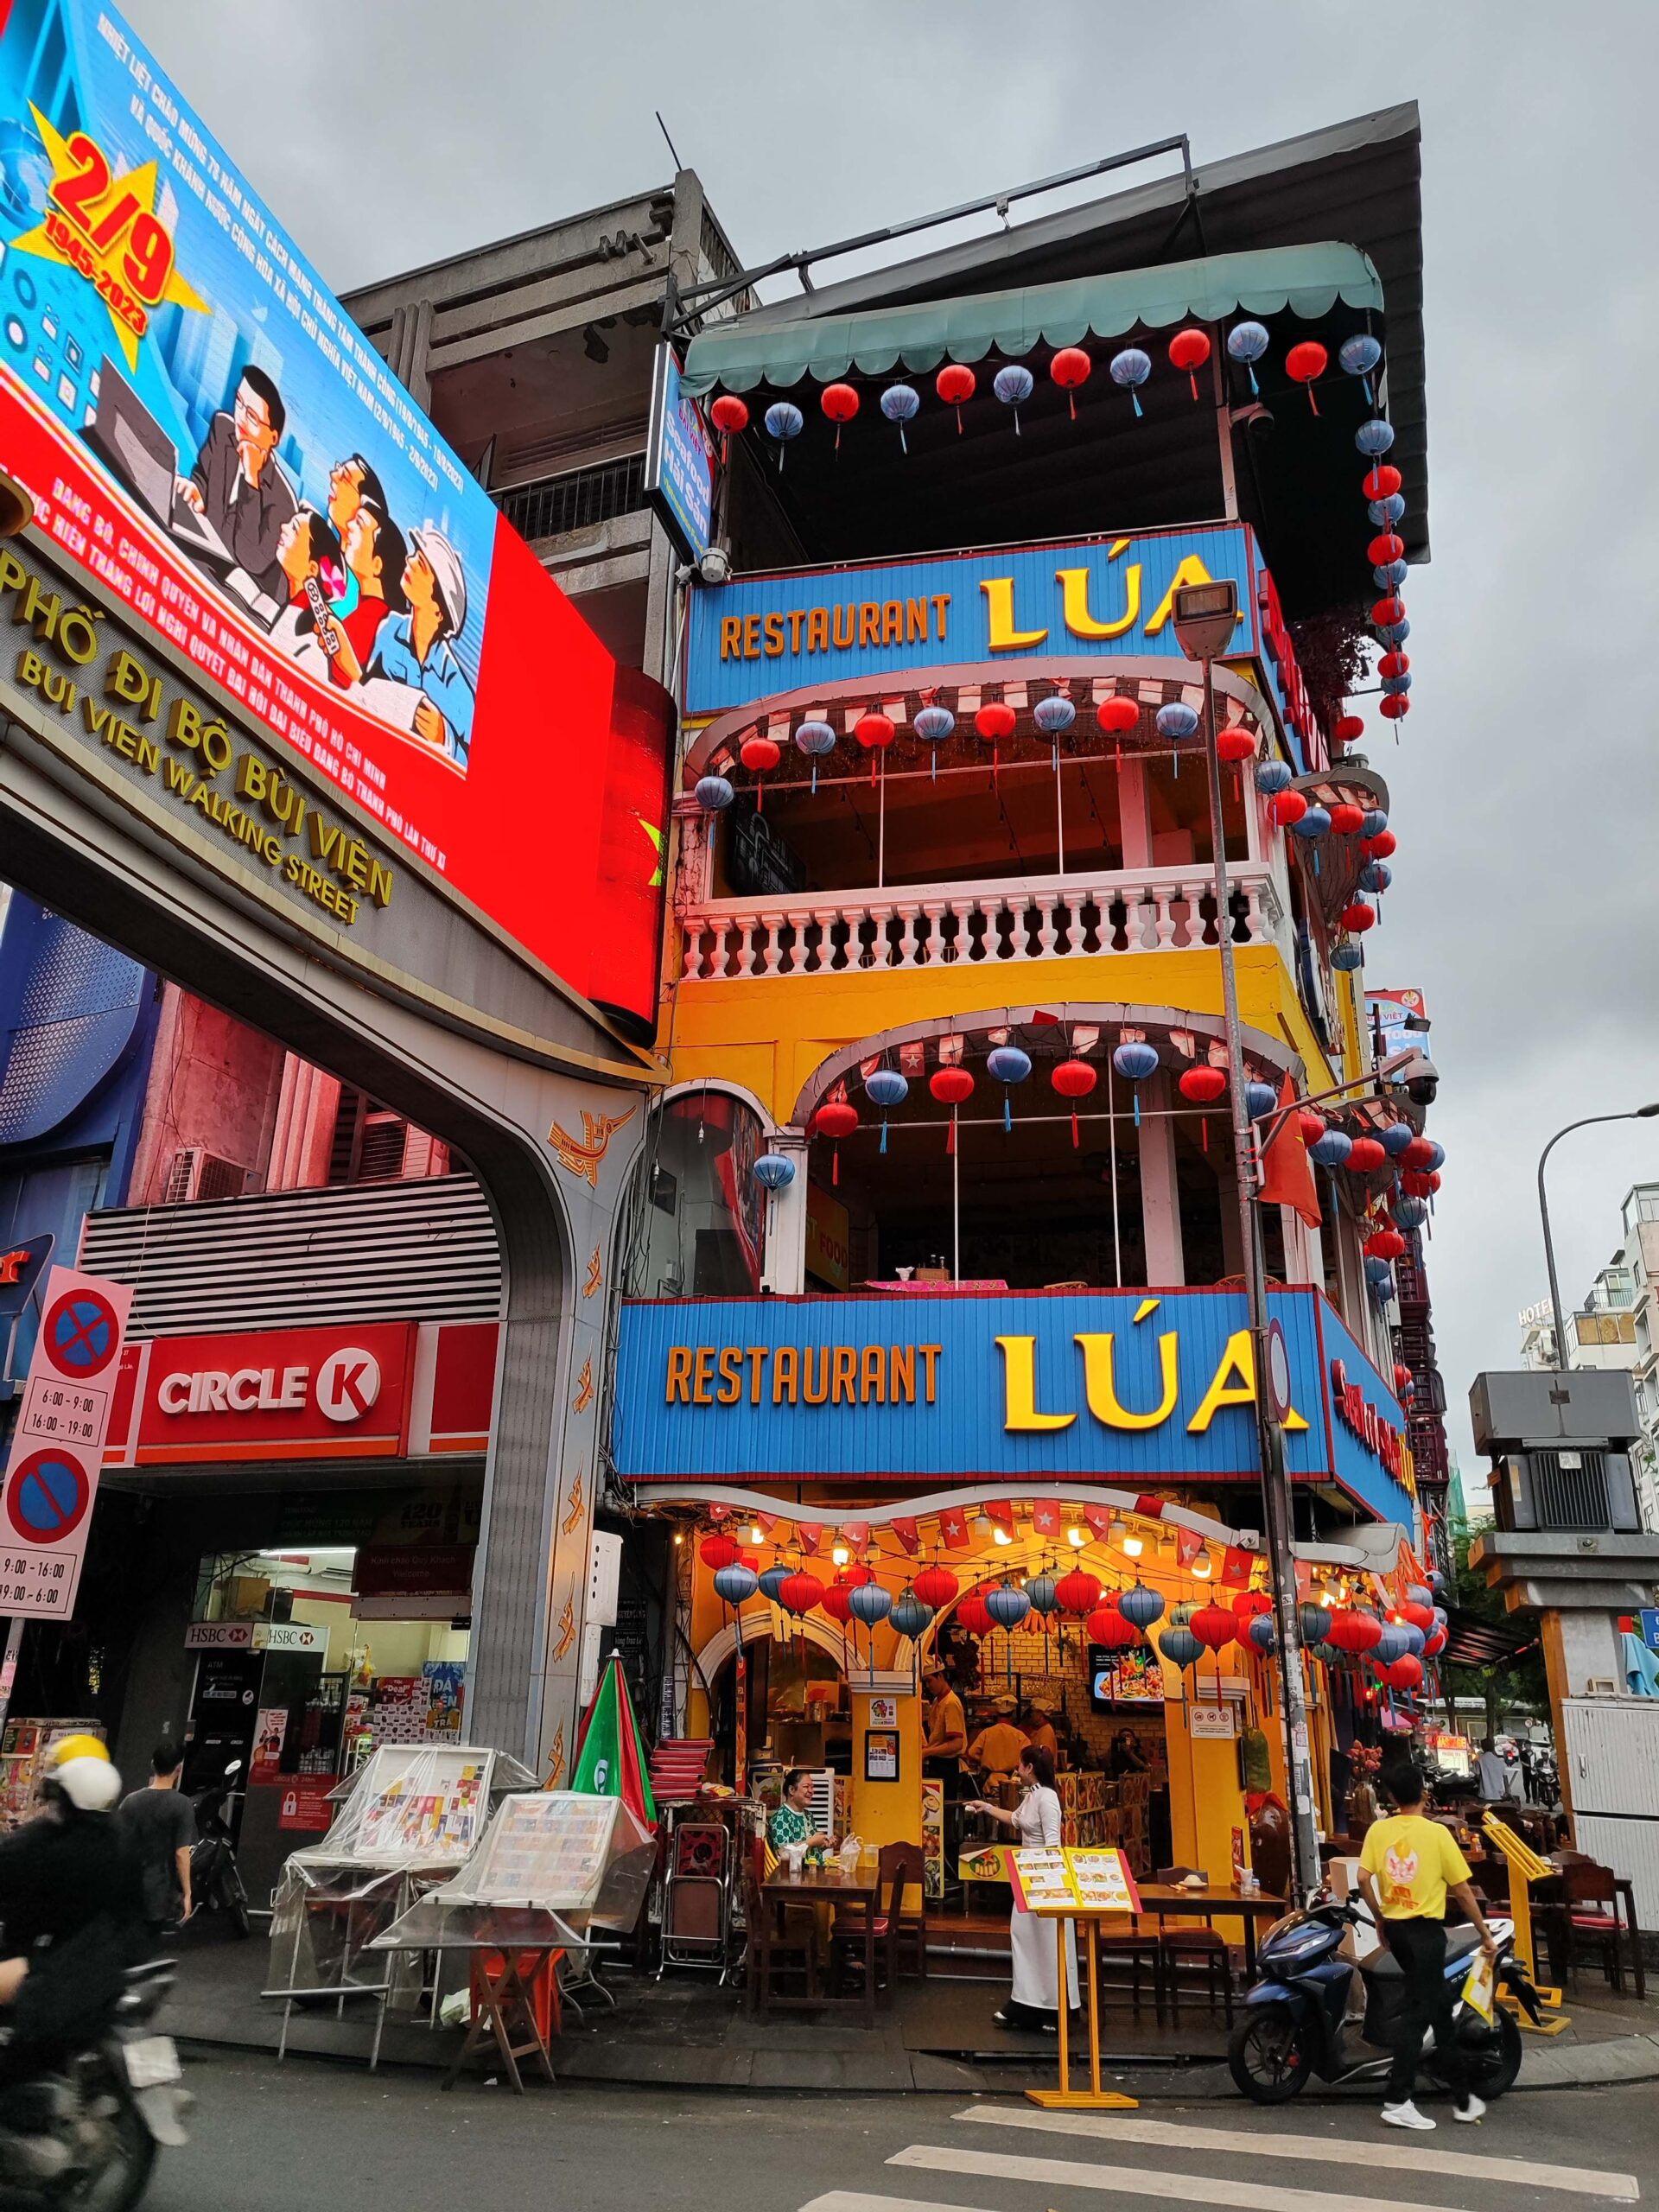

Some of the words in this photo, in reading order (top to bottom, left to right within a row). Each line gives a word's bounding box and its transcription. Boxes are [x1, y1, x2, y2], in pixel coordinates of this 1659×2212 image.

[50, 133, 175, 303] 2/9
[45, 209, 148, 334] 1945-2023
[666, 410, 710, 507] Seafood
[721, 594, 951, 662] RESTAURANT
[19, 650, 78, 714] BUI
[83, 696, 162, 774] VIEN
[164, 756, 283, 866] WALKING
[284, 854, 360, 925] STREET
[110, 650, 163, 722] ĐI
[170, 698, 232, 779] BỘ
[238, 753, 306, 836] BÙI
[311, 811, 393, 908] VIỆN
[363, 757, 386, 791] MINH
[157, 1366, 309, 1414] CIRCLE
[326, 1357, 375, 1418] K
[666, 1344, 942, 1404] RESTAURANT
[995, 1300, 1310, 1433] LÚA
[32, 1414, 57, 1431] 16:00
[67, 1420, 93, 1438] 19:00
[42, 1389, 63, 1408] 6:00
[73, 1396, 93, 1413] 9:00
[3, 1558, 27, 1574] 9:00
[38, 1561, 65, 1579] 16:00
[35, 1588, 59, 1604] 6:00
[190, 1628, 226, 1643] HSBC
[268, 1629, 297, 1645] HSBC
